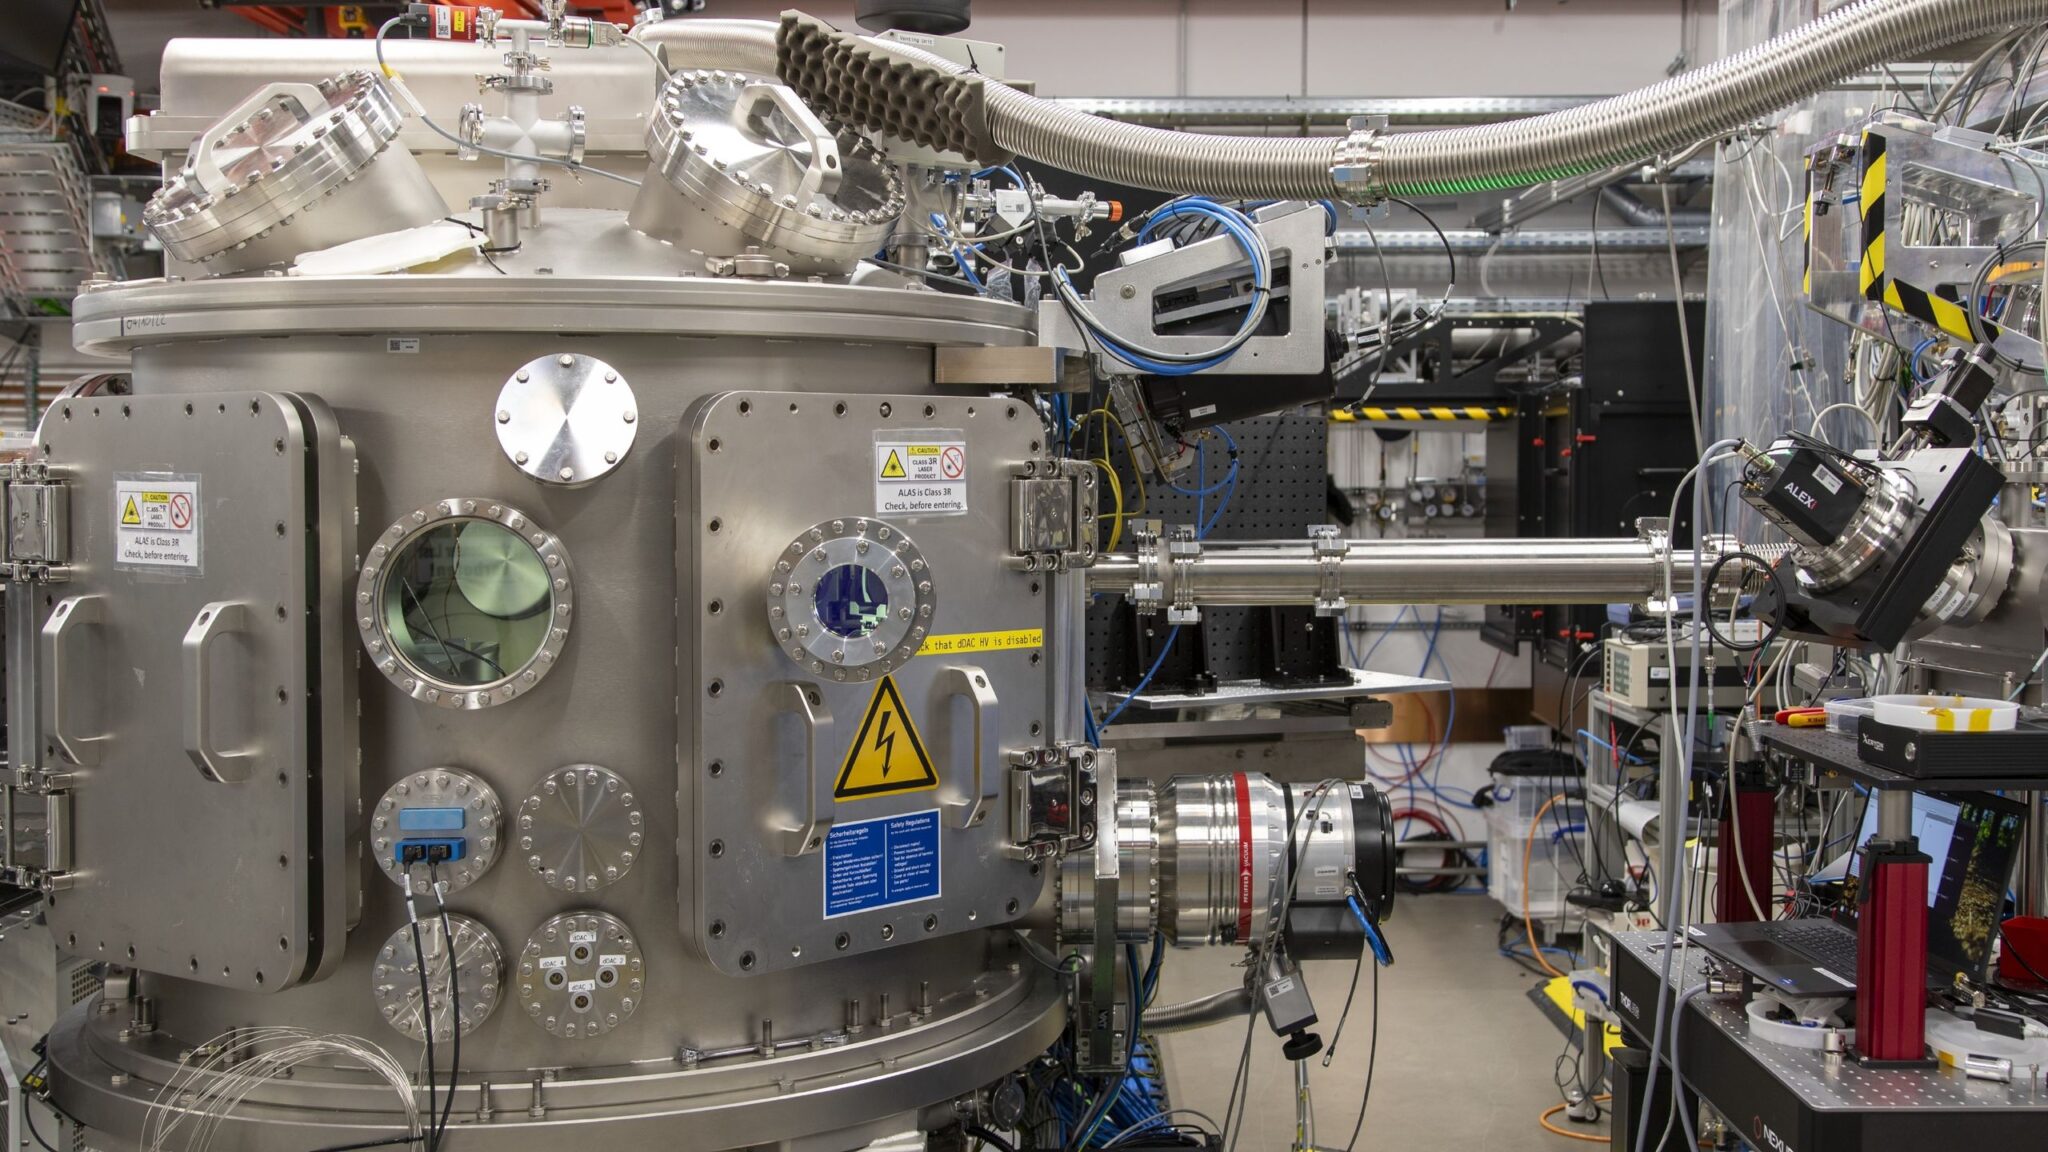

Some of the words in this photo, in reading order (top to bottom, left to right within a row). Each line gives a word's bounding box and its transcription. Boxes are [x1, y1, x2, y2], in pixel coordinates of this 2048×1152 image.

[898, 488, 916, 497] ALAS
[917, 488, 923, 496] is
[924, 488, 942, 496] Class
[943, 488, 952, 496] 3R
[884, 502, 908, 512] Check,
[909, 501, 932, 510] before
[135, 537, 149, 545] ALAS
[150, 537, 155, 545] is
[156, 538, 171, 546] Class
[171, 538, 179, 546] 3R
[125, 549, 143, 560] Check,
[144, 550, 163, 560] before
[935, 641, 952, 650] that
[957, 638, 975, 648] dDAC
[980, 639, 989, 647] HV
[994, 637, 1002, 646] is
[1006, 634, 1041, 645] disabled
[891, 822, 904, 830] Safety
